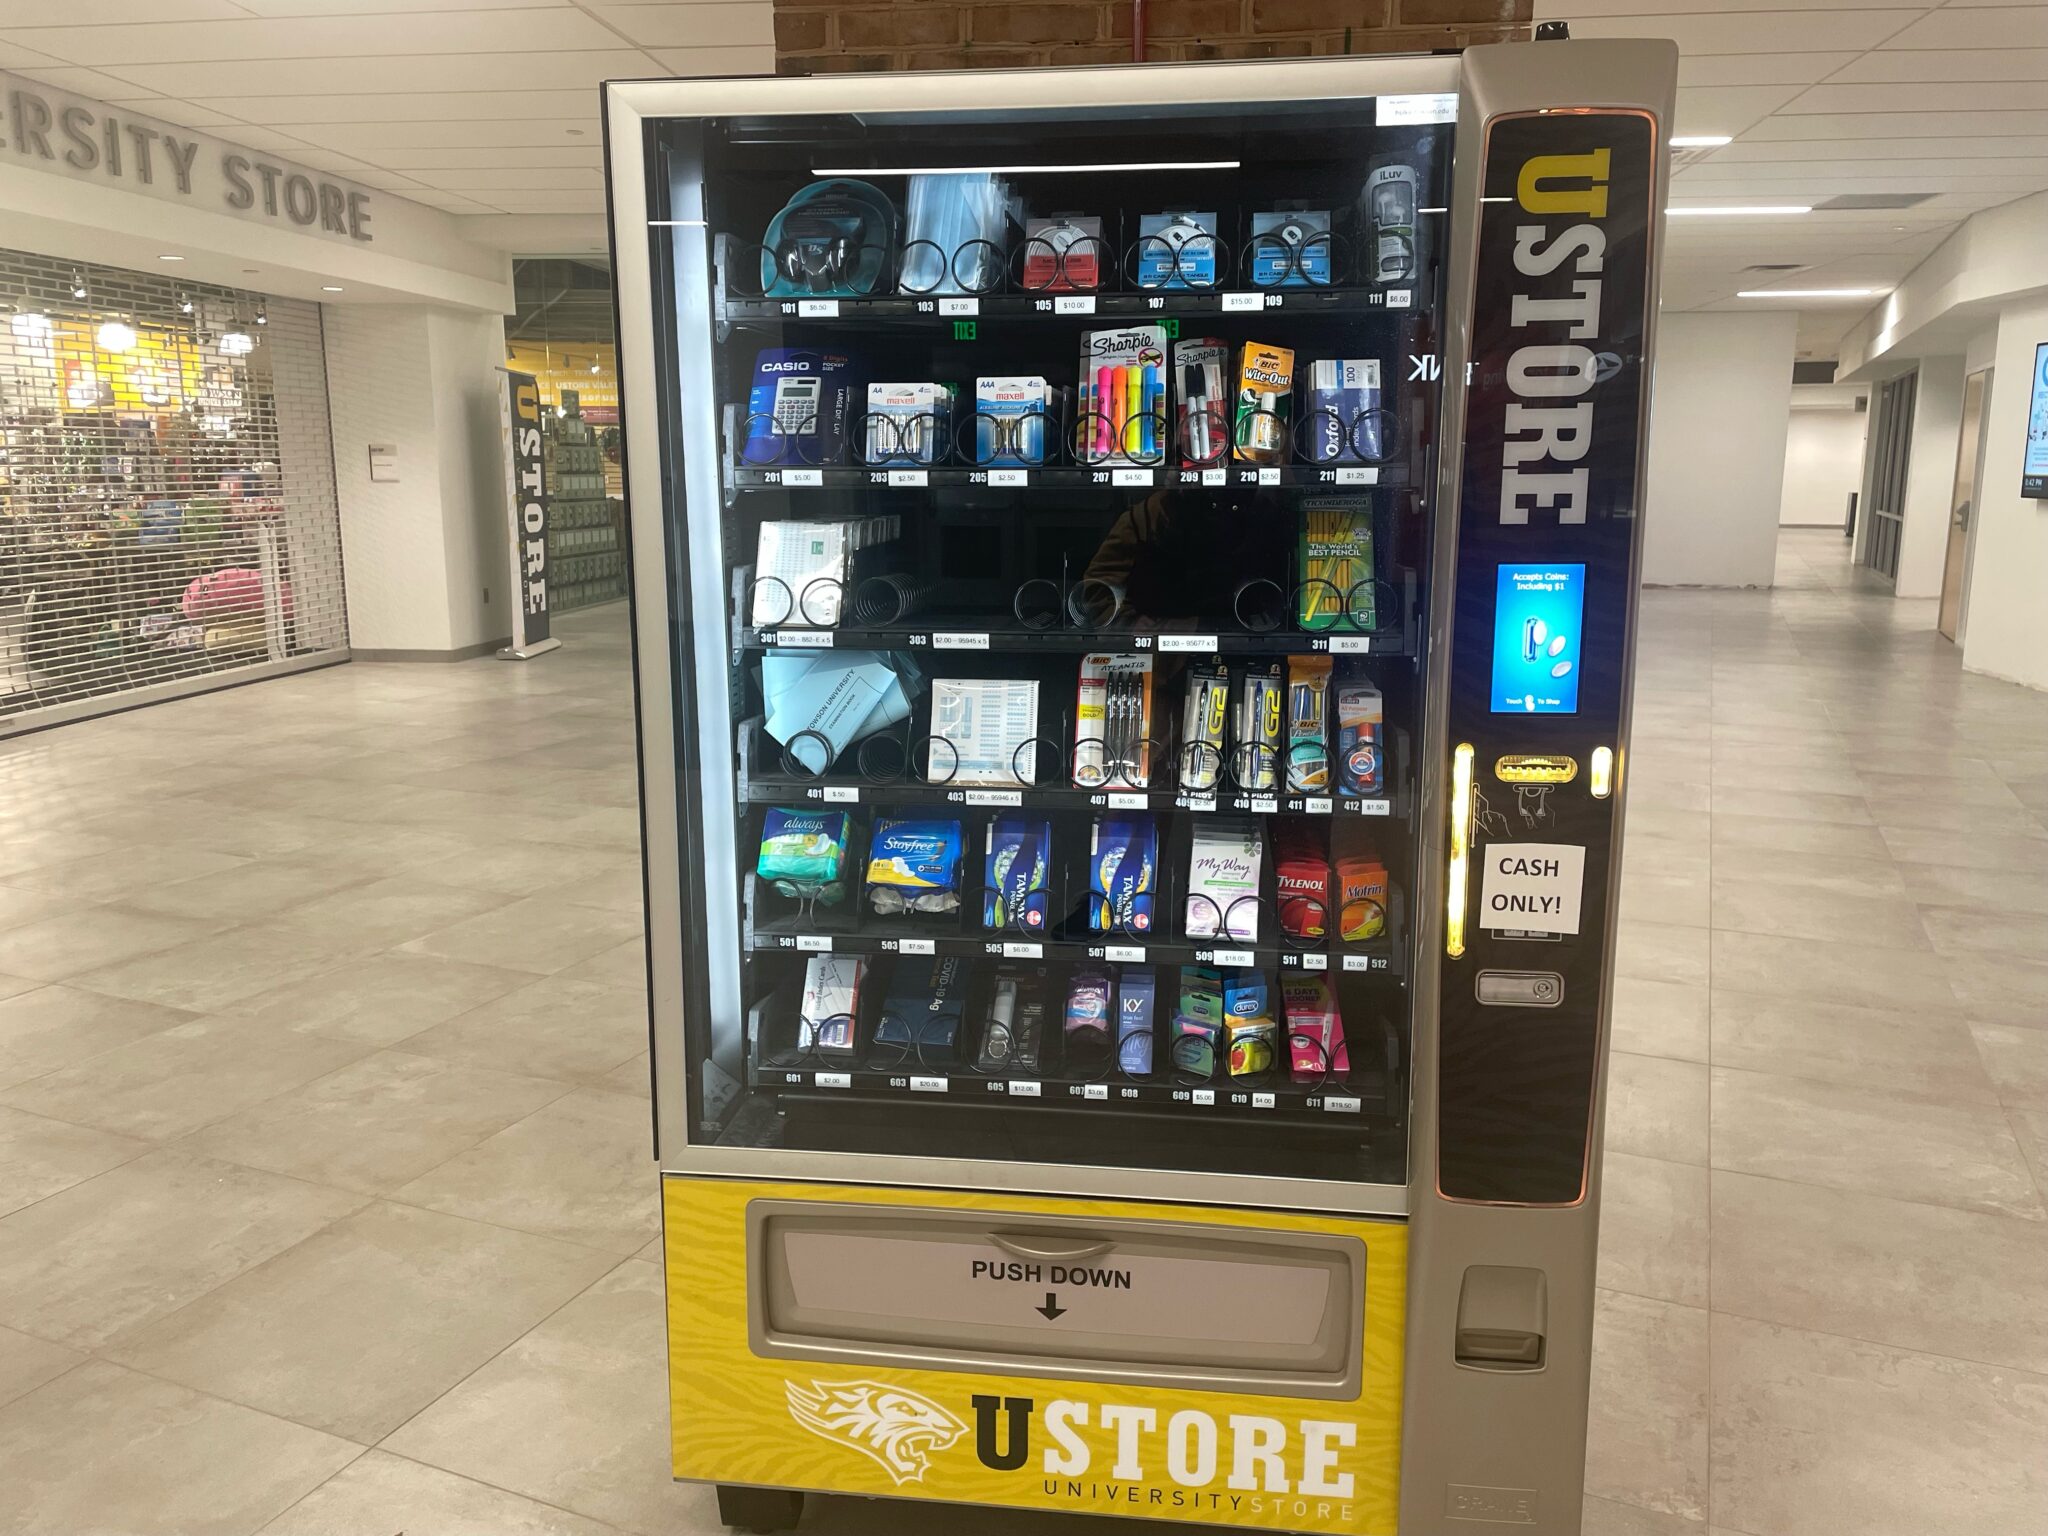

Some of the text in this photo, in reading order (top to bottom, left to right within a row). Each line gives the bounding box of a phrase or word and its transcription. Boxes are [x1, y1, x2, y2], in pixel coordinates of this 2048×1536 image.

[1380, 170, 1402, 180] iLuv
[222, 154, 374, 242] STORE
[1147, 297, 1164, 308] 107
[1230, 297, 1253, 305] $15.00
[1265, 294, 1283, 306] 109
[1368, 293, 1383, 304] 111
[1389, 295, 1409, 303] $6.00
[781, 303, 796, 314] 101
[917, 301, 934, 312] 103
[951, 303, 968, 311] $7.00
[1034, 299, 1052, 310] 105
[1093, 334, 1154, 356] Sharpie
[1176, 350, 1217, 366] Sharpie
[761, 361, 810, 372] CASIO
[1346, 366, 1356, 383] 100
[1027, 380, 1033, 388] 4
[918, 386, 924, 394] 4
[836, 388, 845, 410] LARGE
[886, 396, 916, 405] maxell
[995, 391, 1025, 400] maxell
[1325, 405, 1339, 457] Oxford
[764, 472, 781, 483] 201
[870, 473, 887, 483] 203
[969, 473, 987, 483] 205
[1092, 472, 1110, 483] 207
[1180, 472, 1199, 482] 209
[1240, 471, 1258, 482] 210
[1319, 470, 1335, 481] 211
[1346, 472, 1365, 480] $1.25
[1512, 573, 1543, 582] Accepts
[1517, 582, 1565, 592] Including $1
[760, 633, 777, 643] 301
[909, 635, 927, 645] 303
[1134, 637, 1152, 648] 307
[1312, 639, 1328, 650] 311
[1101, 661, 1146, 671] ATLANTIS
[807, 668, 856, 731] TOWSON UNIVERSITY
[807, 789, 822, 798] 401
[947, 792, 964, 802] 403
[1190, 791, 1213, 799] PILOT
[1251, 790, 1273, 799] PILOT
[1090, 795, 1106, 805] 407
[1233, 799, 1250, 809] 410
[1288, 800, 1303, 810] 411
[1343, 801, 1360, 811] 412
[783, 816, 824, 833] always
[883, 836, 935, 853] Stayfree
[1196, 857, 1250, 880] My Way
[1498, 857, 1560, 877] CASH
[1277, 875, 1324, 890] TYLENOL
[1346, 883, 1383, 898] Motrin
[1491, 893, 1561, 914] ONLY!
[779, 937, 795, 947] 501
[881, 940, 898, 950] 503
[985, 943, 1002, 953] 505
[1088, 947, 1104, 957] 507
[1195, 951, 1213, 961] 509
[1282, 955, 1298, 965] 511
[1306, 958, 1323, 966] $2.50
[1347, 960, 1365, 968] $3.00
[1371, 959, 1388, 969] 512
[936, 957, 954, 997] COVID-19
[929, 998, 943, 1011] Ag
[1235, 1002, 1257, 1012] durex
[786, 1073, 801, 1083] 601
[890, 1078, 907, 1087] 603
[987, 1082, 1004, 1091] 605
[1069, 1086, 1084, 1095] 607
[1121, 1089, 1139, 1098] 608
[1172, 1091, 1190, 1100] 609
[1231, 1094, 1248, 1103] 610
[1306, 1098, 1321, 1107] 611
[1331, 1101, 1352, 1109] $19.50
[971, 1260, 1131, 1289] PUSH DOWN
